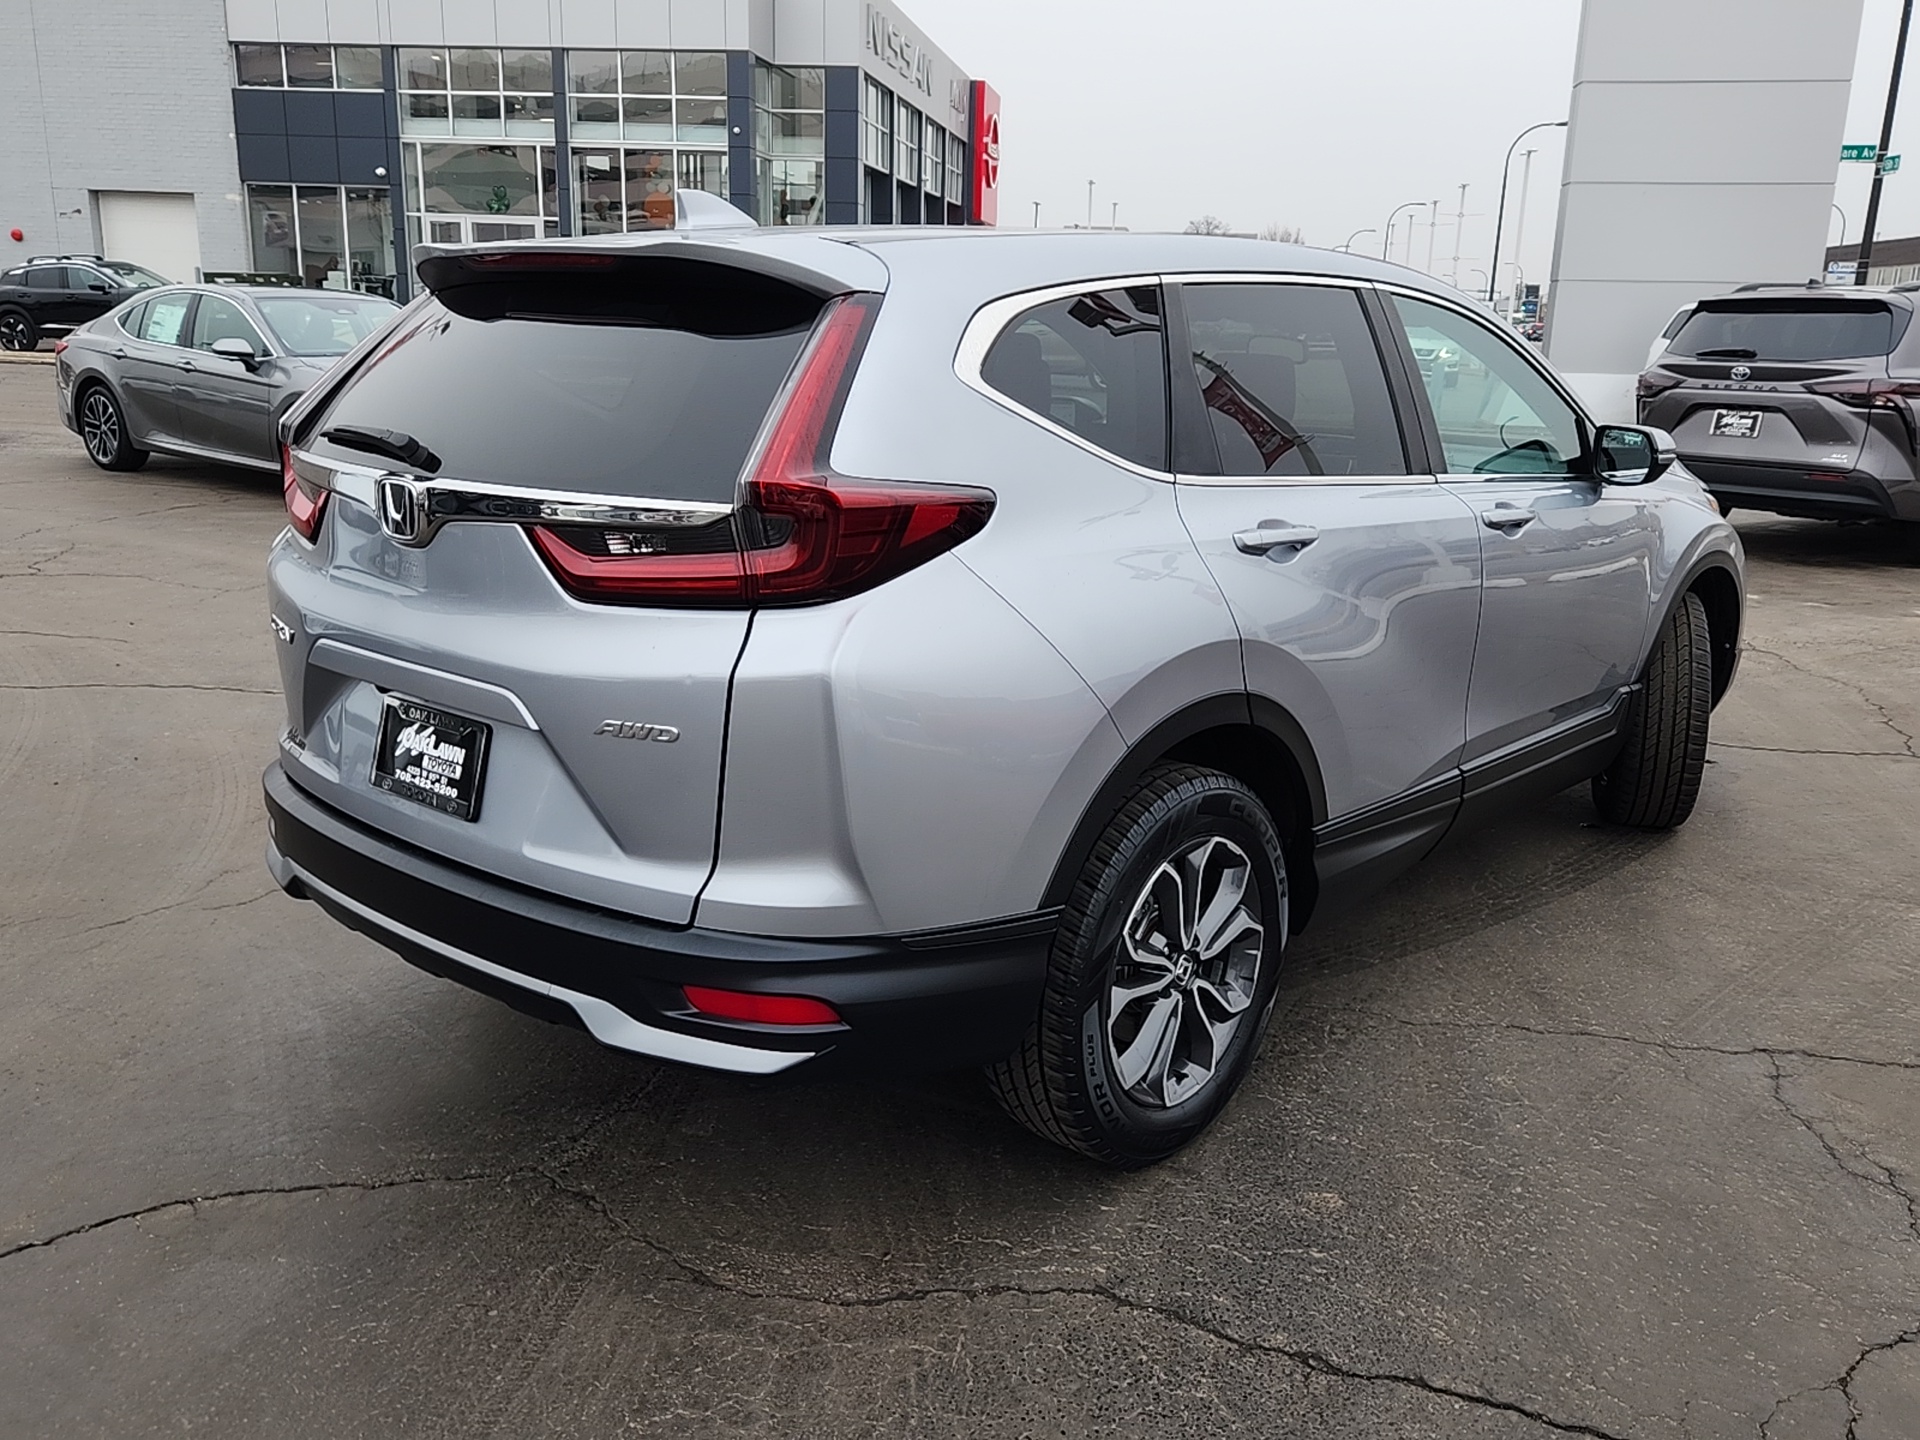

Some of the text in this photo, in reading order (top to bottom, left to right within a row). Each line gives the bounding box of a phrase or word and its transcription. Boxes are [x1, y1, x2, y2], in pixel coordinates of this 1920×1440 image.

[866, 3, 932, 97] NISSAN
[1842, 149, 1858, 158] are
[1701, 383, 1779, 392] SIENNA
[593, 719, 680, 742] AWD
[427, 757, 457, 776] TOYOTA
[395, 768, 458, 798] 708-423-5200
[401, 783, 437, 806] TOYOTA
[1229, 799, 1287, 900] COOPER
[1086, 1034, 1097, 1077] PLUS
